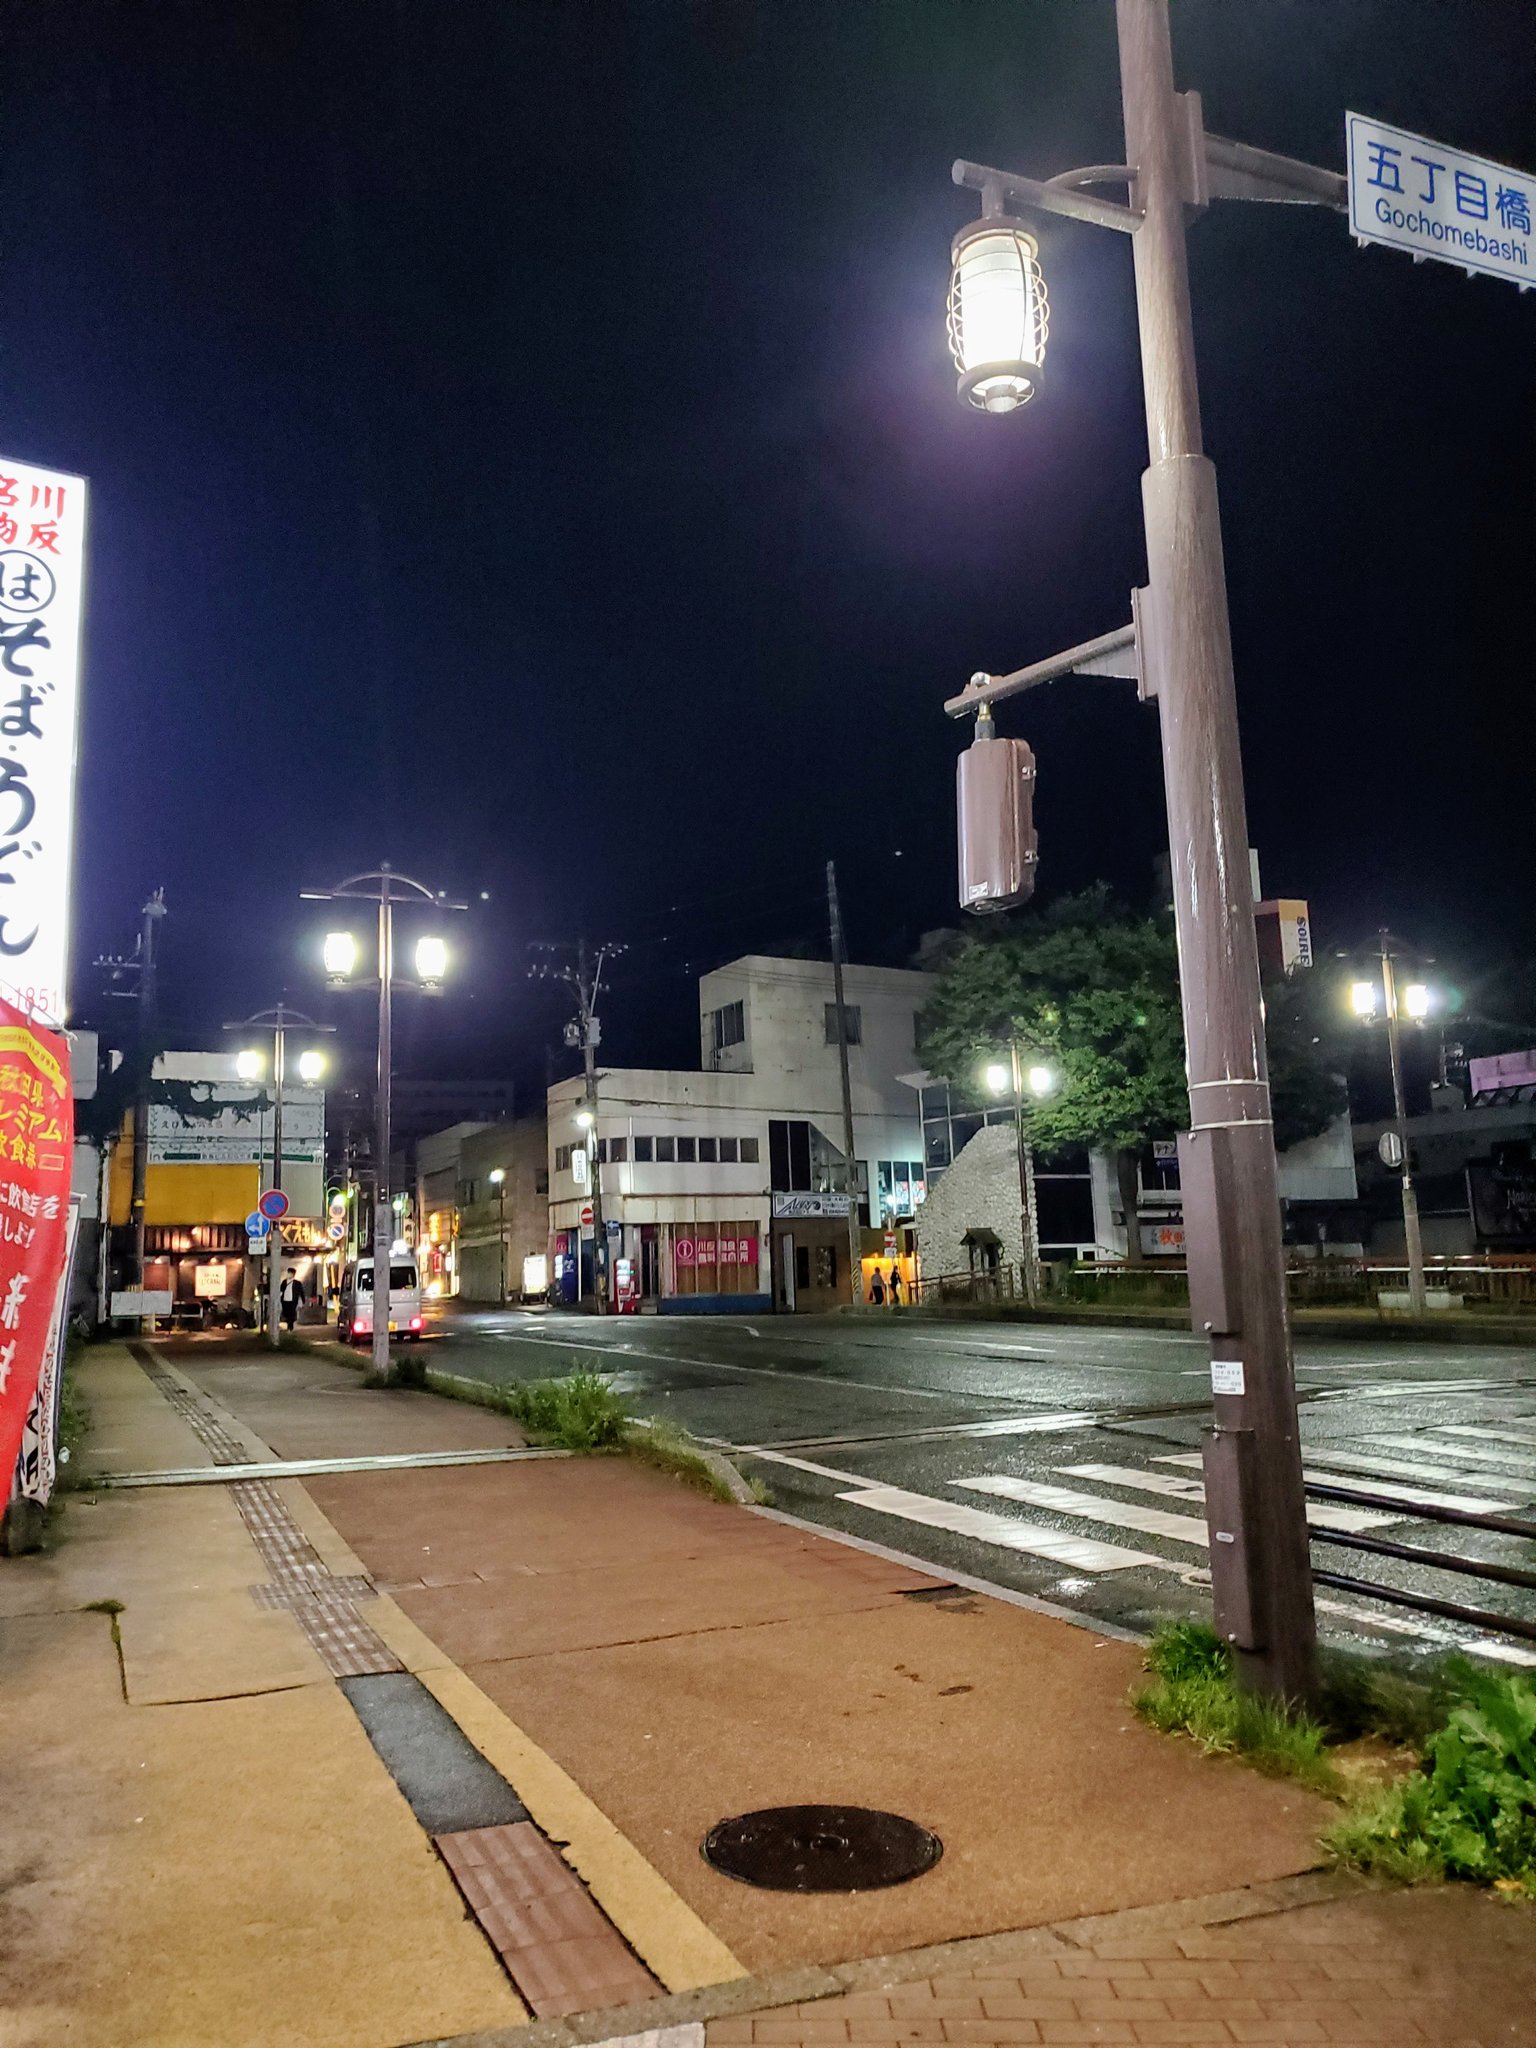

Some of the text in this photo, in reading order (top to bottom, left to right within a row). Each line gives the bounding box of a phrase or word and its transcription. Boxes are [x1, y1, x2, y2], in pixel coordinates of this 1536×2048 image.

[1367, 141, 1531, 236] 五丁目橋
[1375, 198, 1528, 265] Gochomebashi
[27, 485, 66, 555] 川反
